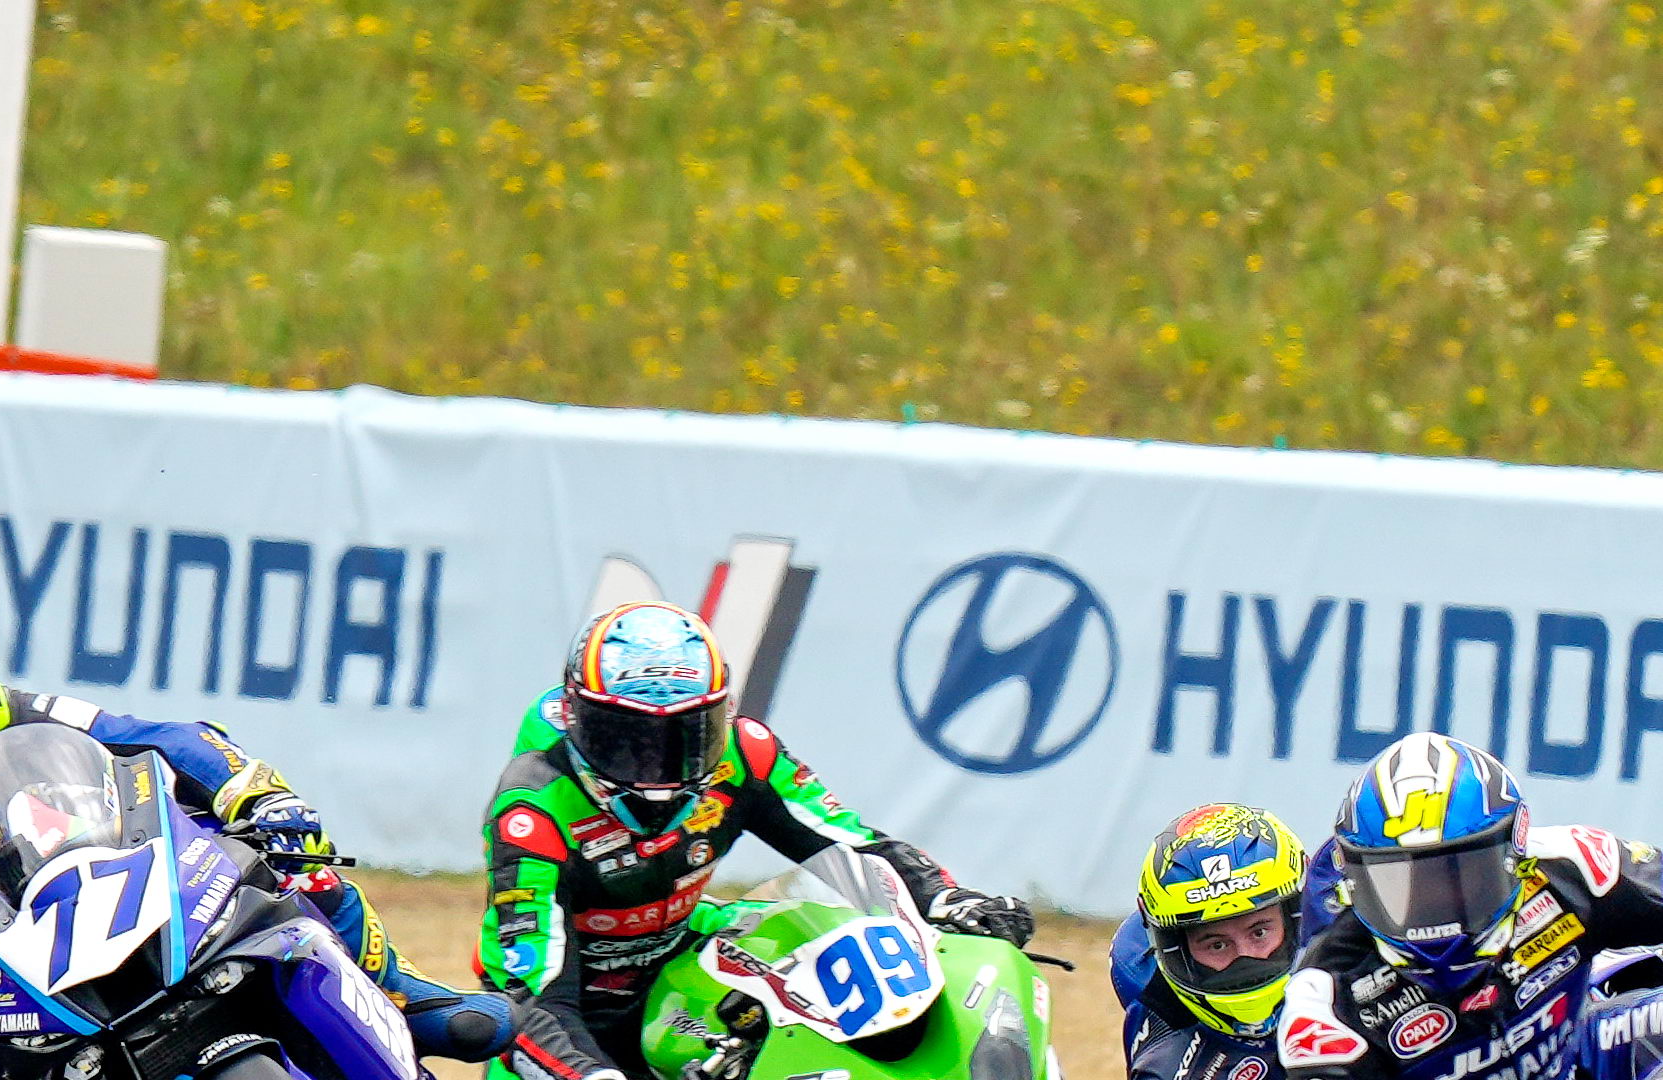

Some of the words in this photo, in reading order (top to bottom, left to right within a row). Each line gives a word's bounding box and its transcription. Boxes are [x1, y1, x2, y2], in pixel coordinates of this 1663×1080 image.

[616, 666, 699, 681] LS2
[188, 872, 236, 925] YAMAHA
[1186, 872, 1260, 904] SHARK
[31, 843, 155, 993] 77
[815, 925, 932, 1036] 99
[1402, 1016, 1441, 1046] PATA
[197, 1034, 263, 1065] YAMAHA
